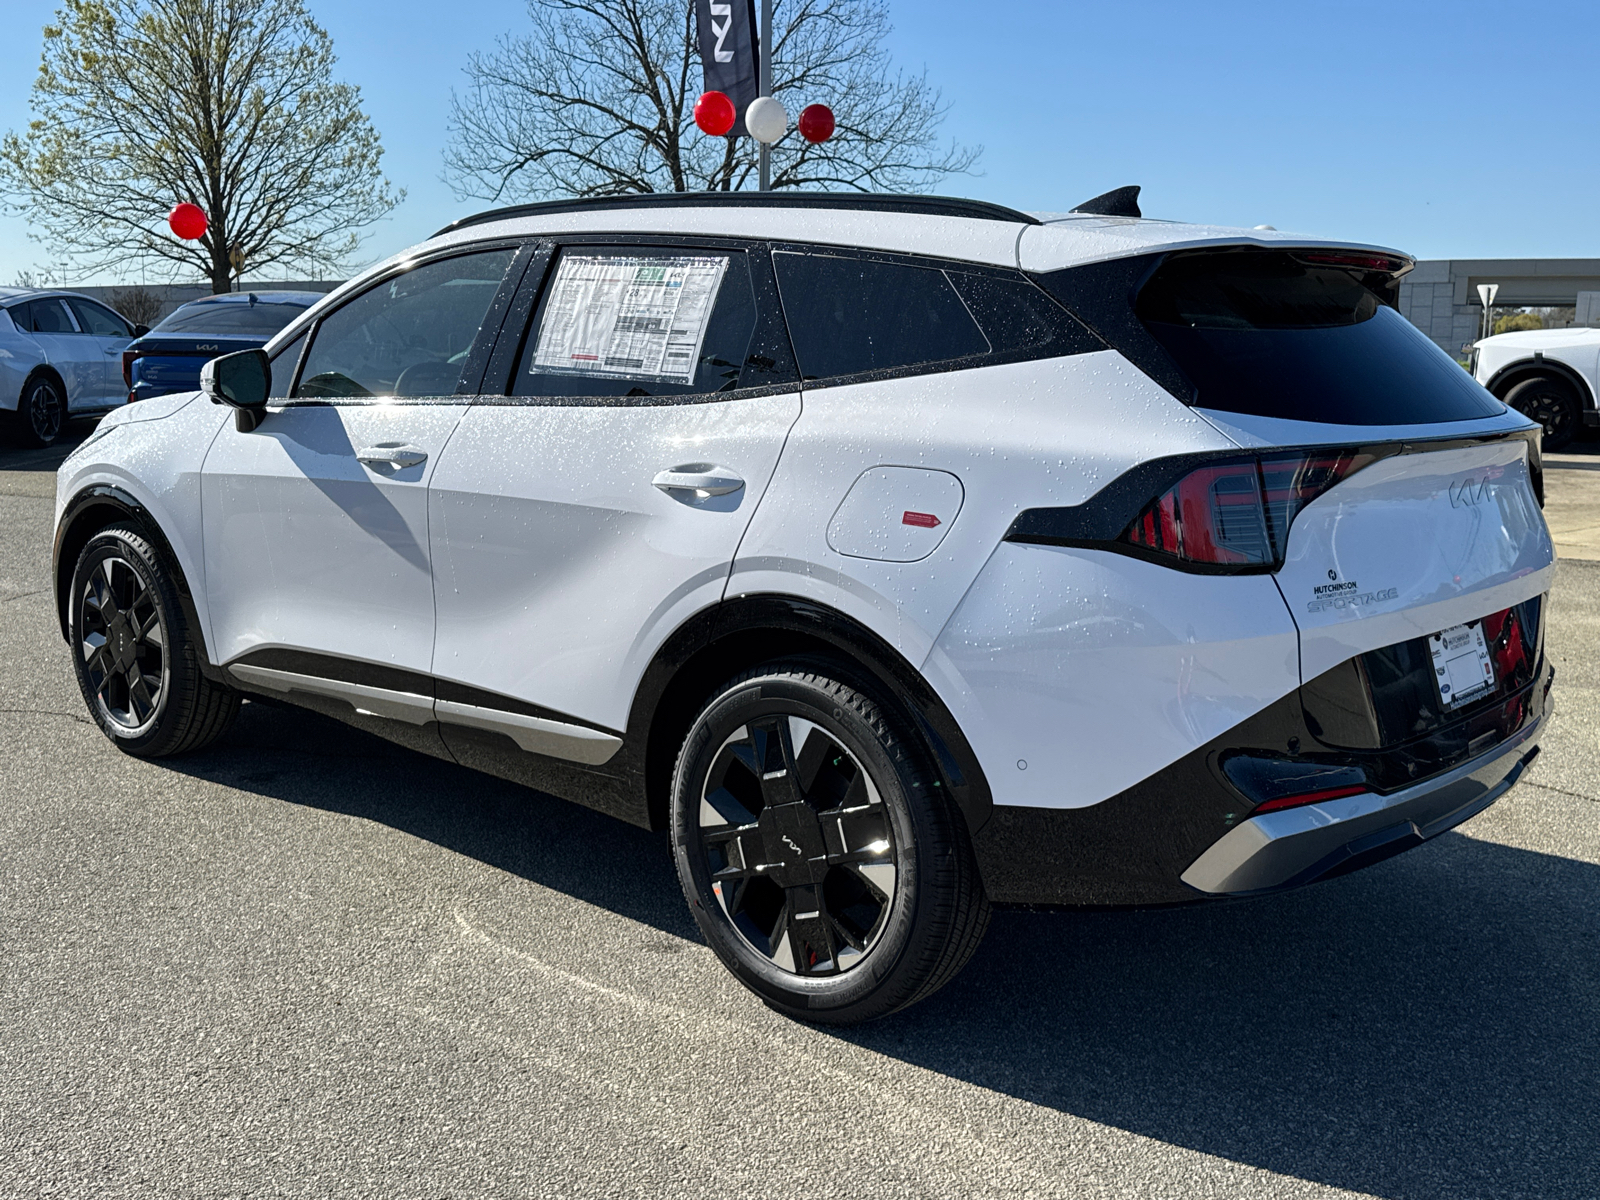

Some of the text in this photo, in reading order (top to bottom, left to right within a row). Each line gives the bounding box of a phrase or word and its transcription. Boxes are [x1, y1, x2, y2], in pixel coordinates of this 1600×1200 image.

[1449, 476, 1490, 509] KIA
[1313, 581, 1357, 595] HUTCHINSON
[1316, 592, 1343, 600] AUTOMOTIVE
[1307, 587, 1399, 613] SPORTAGE
